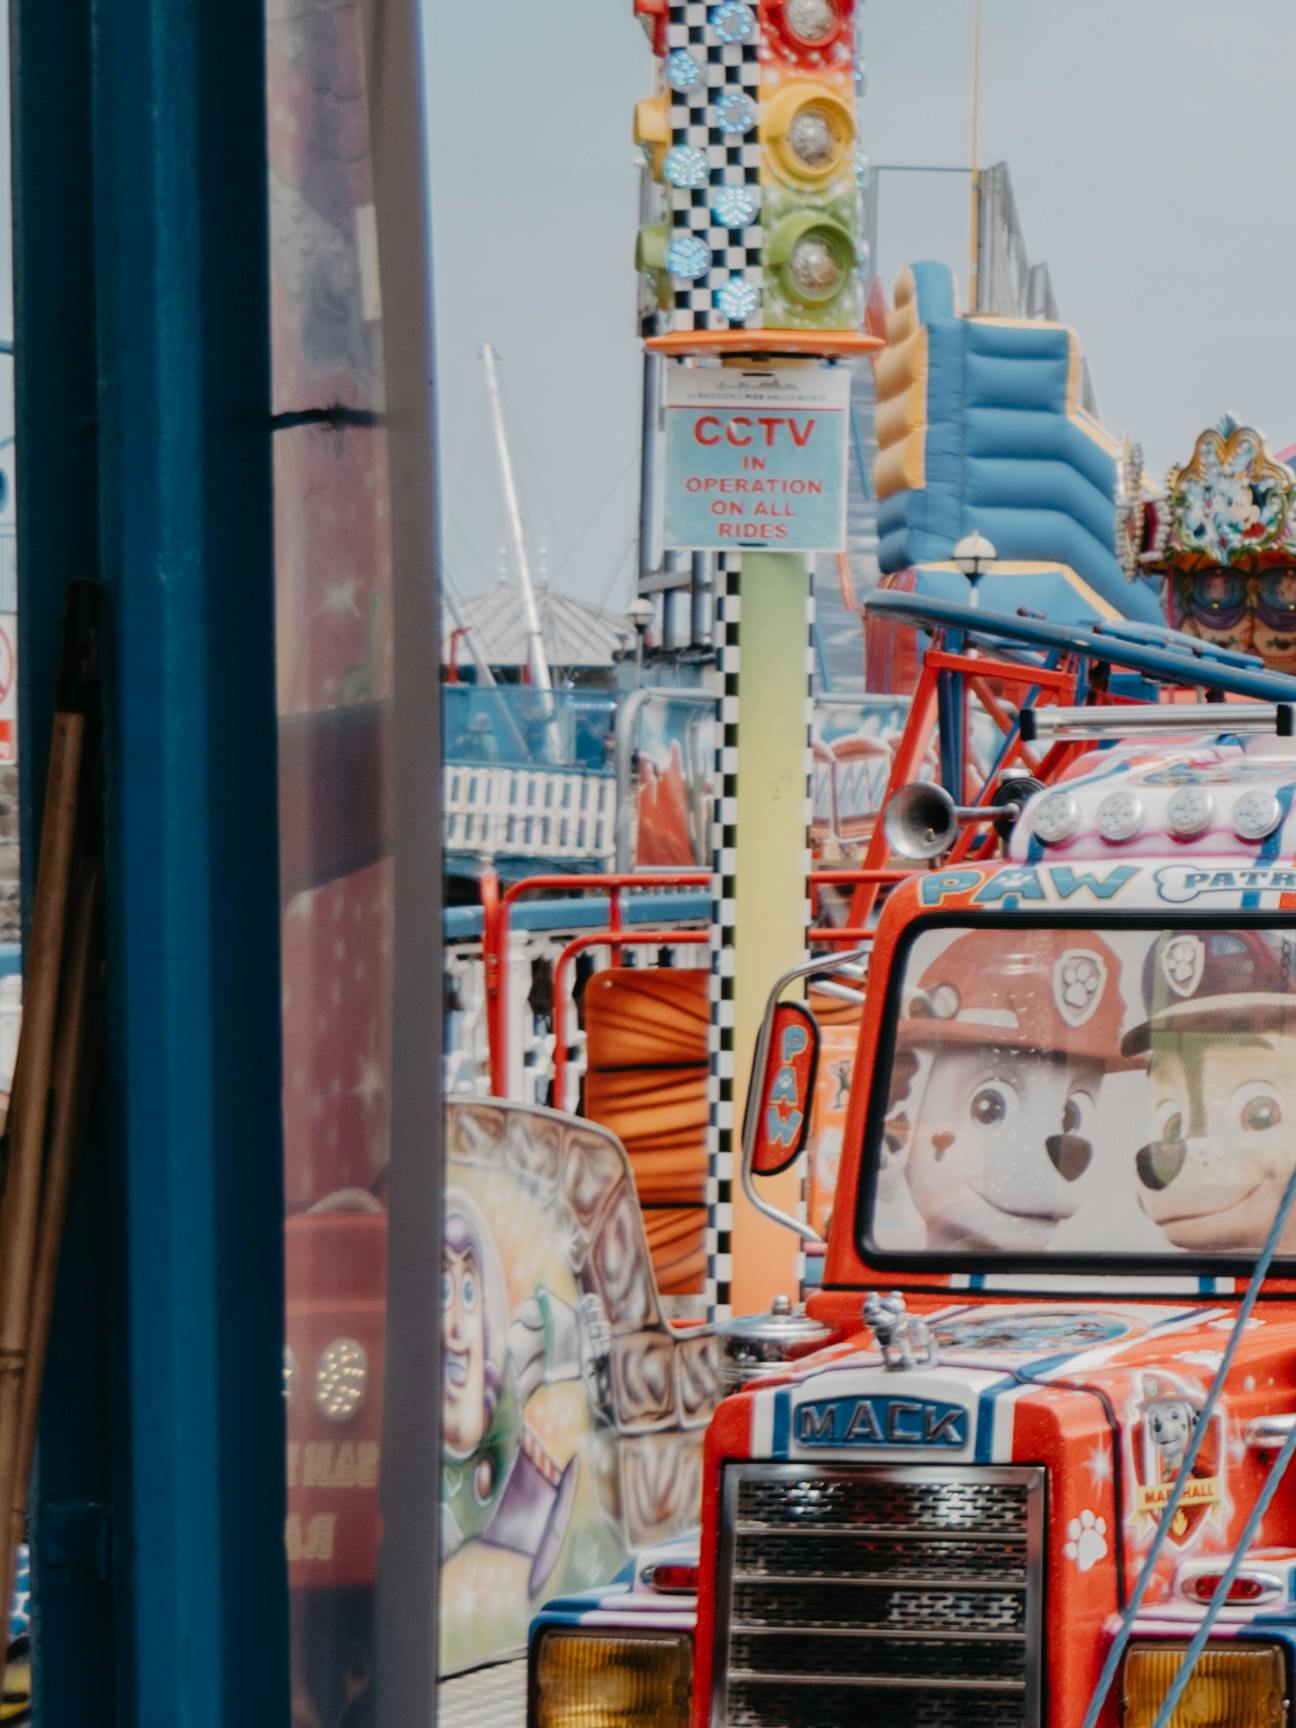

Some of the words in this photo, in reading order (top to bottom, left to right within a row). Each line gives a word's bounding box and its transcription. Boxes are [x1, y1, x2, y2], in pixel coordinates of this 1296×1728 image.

[694, 415, 816, 447] CCTV
[742, 455, 766, 471] IN
[685, 476, 822, 495] OPERATION
[710, 499, 744, 515] ON
[753, 501, 796, 517] ALL
[718, 522, 788, 539] RIDES
[917, 864, 1143, 907] PAW
[766, 1024, 808, 1147] PAW
[800, 1399, 966, 1442] MACK
